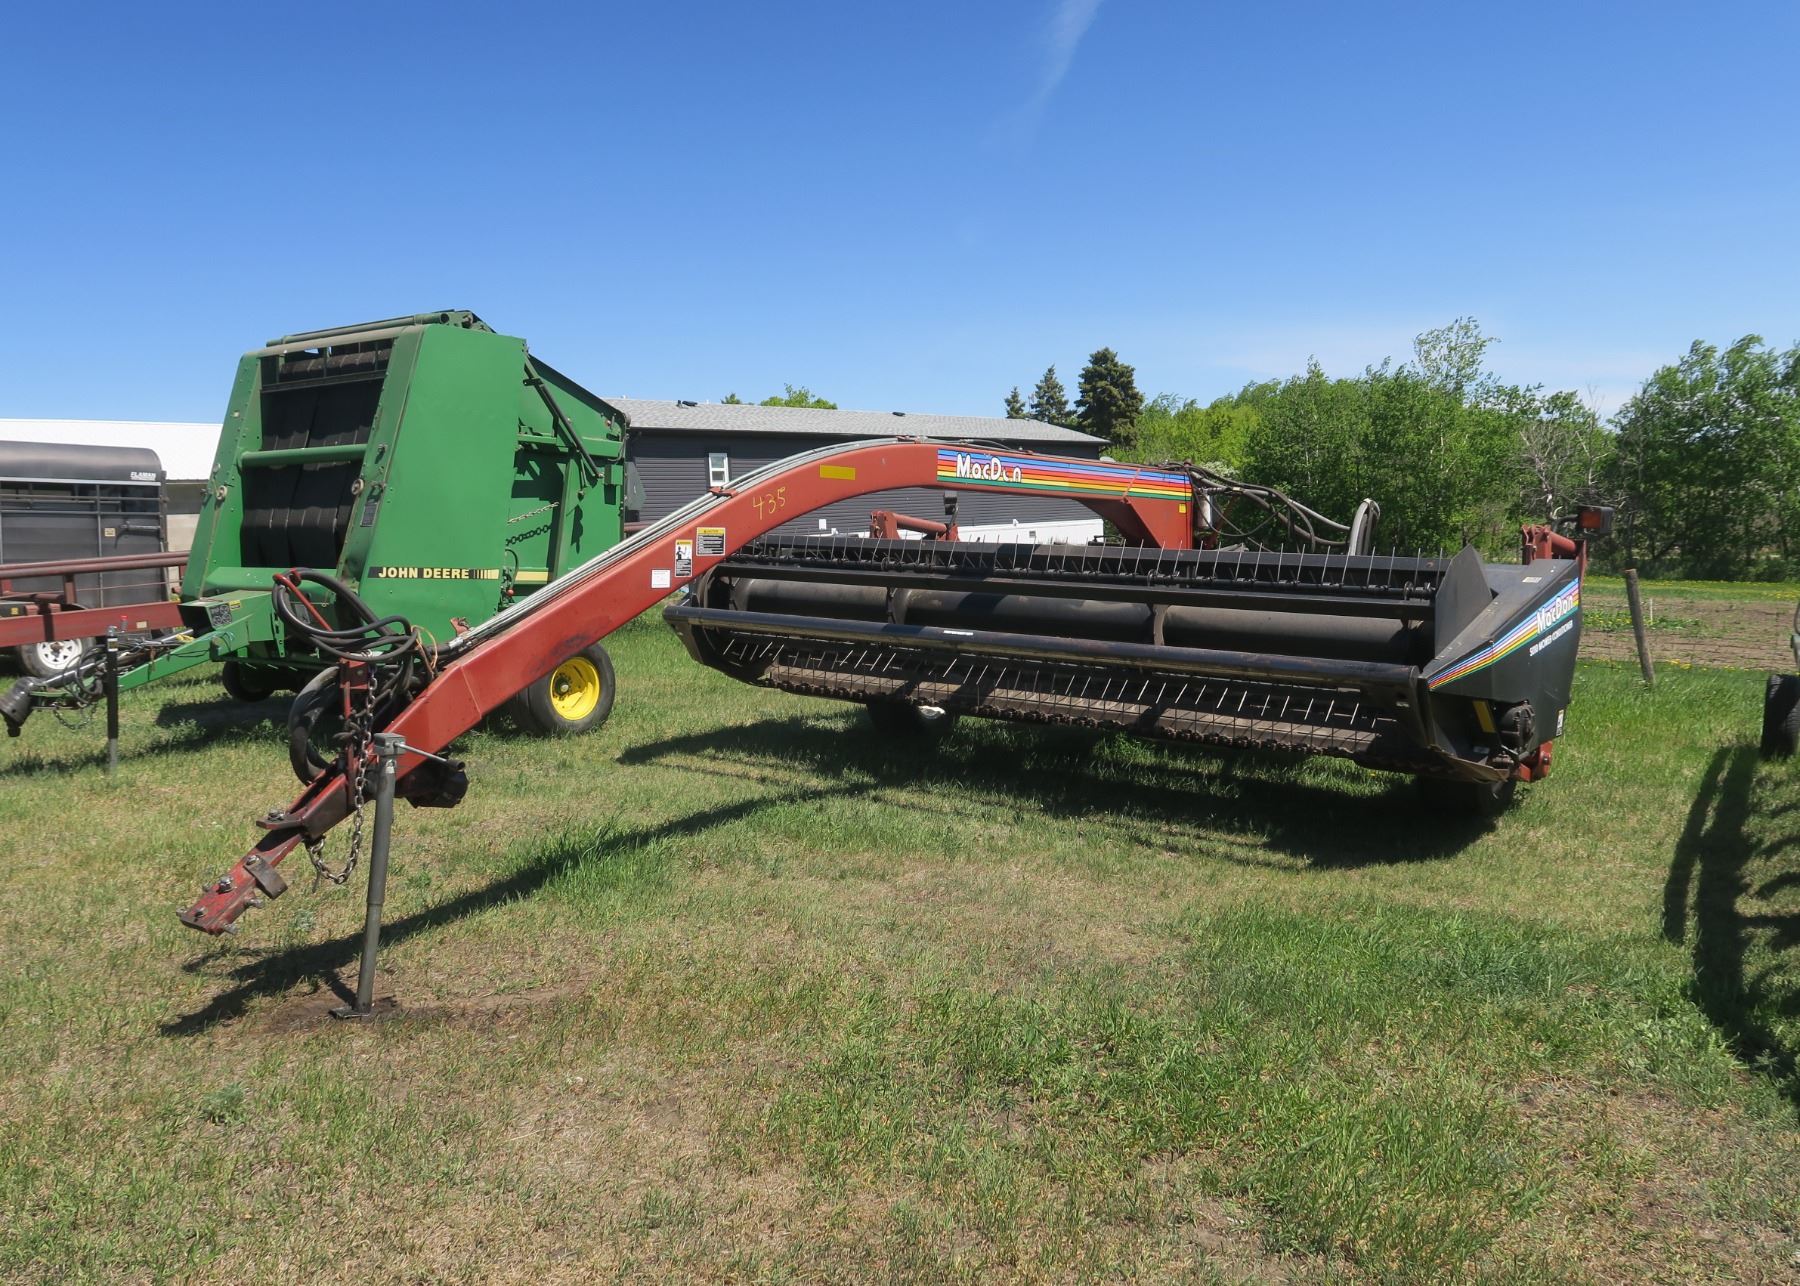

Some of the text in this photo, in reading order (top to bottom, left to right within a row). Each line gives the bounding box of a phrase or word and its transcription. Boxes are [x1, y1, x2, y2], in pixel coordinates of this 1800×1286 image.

[752, 486, 786, 520] 435
[378, 567, 470, 579] JOHN DEERE
[1536, 595, 1573, 634] MacDon
